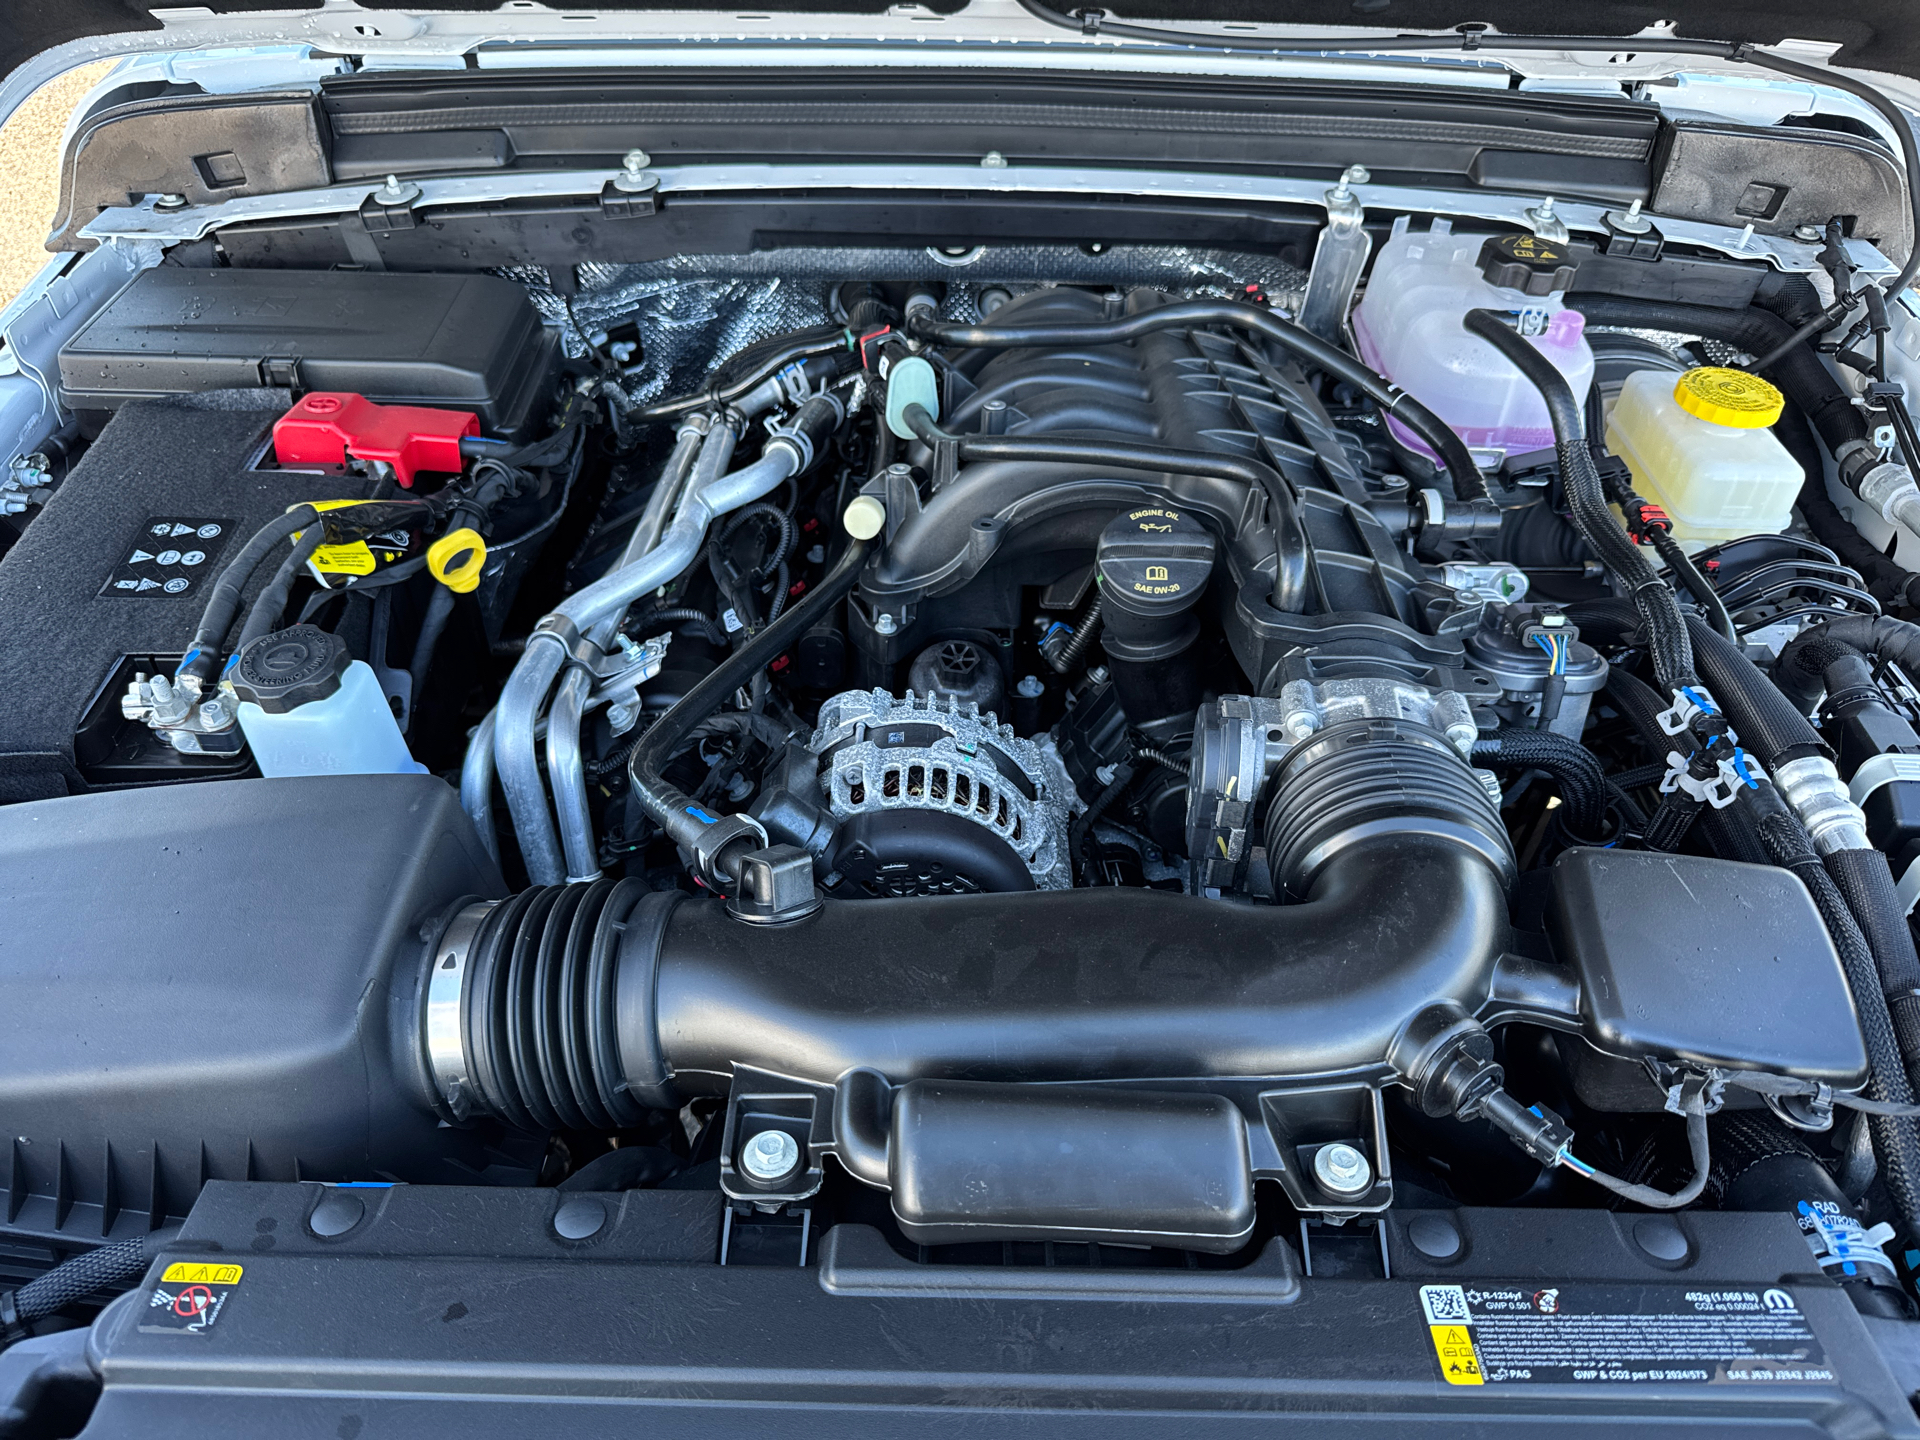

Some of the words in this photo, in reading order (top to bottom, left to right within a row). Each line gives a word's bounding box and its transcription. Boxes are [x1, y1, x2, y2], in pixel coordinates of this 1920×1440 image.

[1129, 509, 1164, 521] ENGINE
[1165, 510, 1180, 522] OIL
[1133, 582, 1153, 594] SAE
[1154, 583, 1181, 595] 0W-20
[260, 635, 279, 647] USE
[281, 629, 326, 645] APPROVED
[304, 654, 325, 674] FLUID
[1812, 1201, 1840, 1214] RAD
[1482, 1291, 1522, 1302] R-1234yf
[1685, 1292, 1711, 1303] 482g
[1743, 1292, 1759, 1303] lb)
[1485, 1301, 1507, 1310] GWP
[1508, 1301, 1532, 1310] 0.501
[1694, 1302, 1715, 1311] CO2
[1715, 1303, 1727, 1312] eq
[1509, 1369, 1532, 1379] PAG
[1573, 1370, 1598, 1380] GWP
[1599, 1370, 1608, 1380] &
[1609, 1370, 1631, 1380] CO2
[1631, 1371, 1648, 1382] per
[1649, 1370, 1665, 1380] EU
[1665, 1370, 1708, 1380] 2024/573
[1727, 1370, 1750, 1380] SAE
